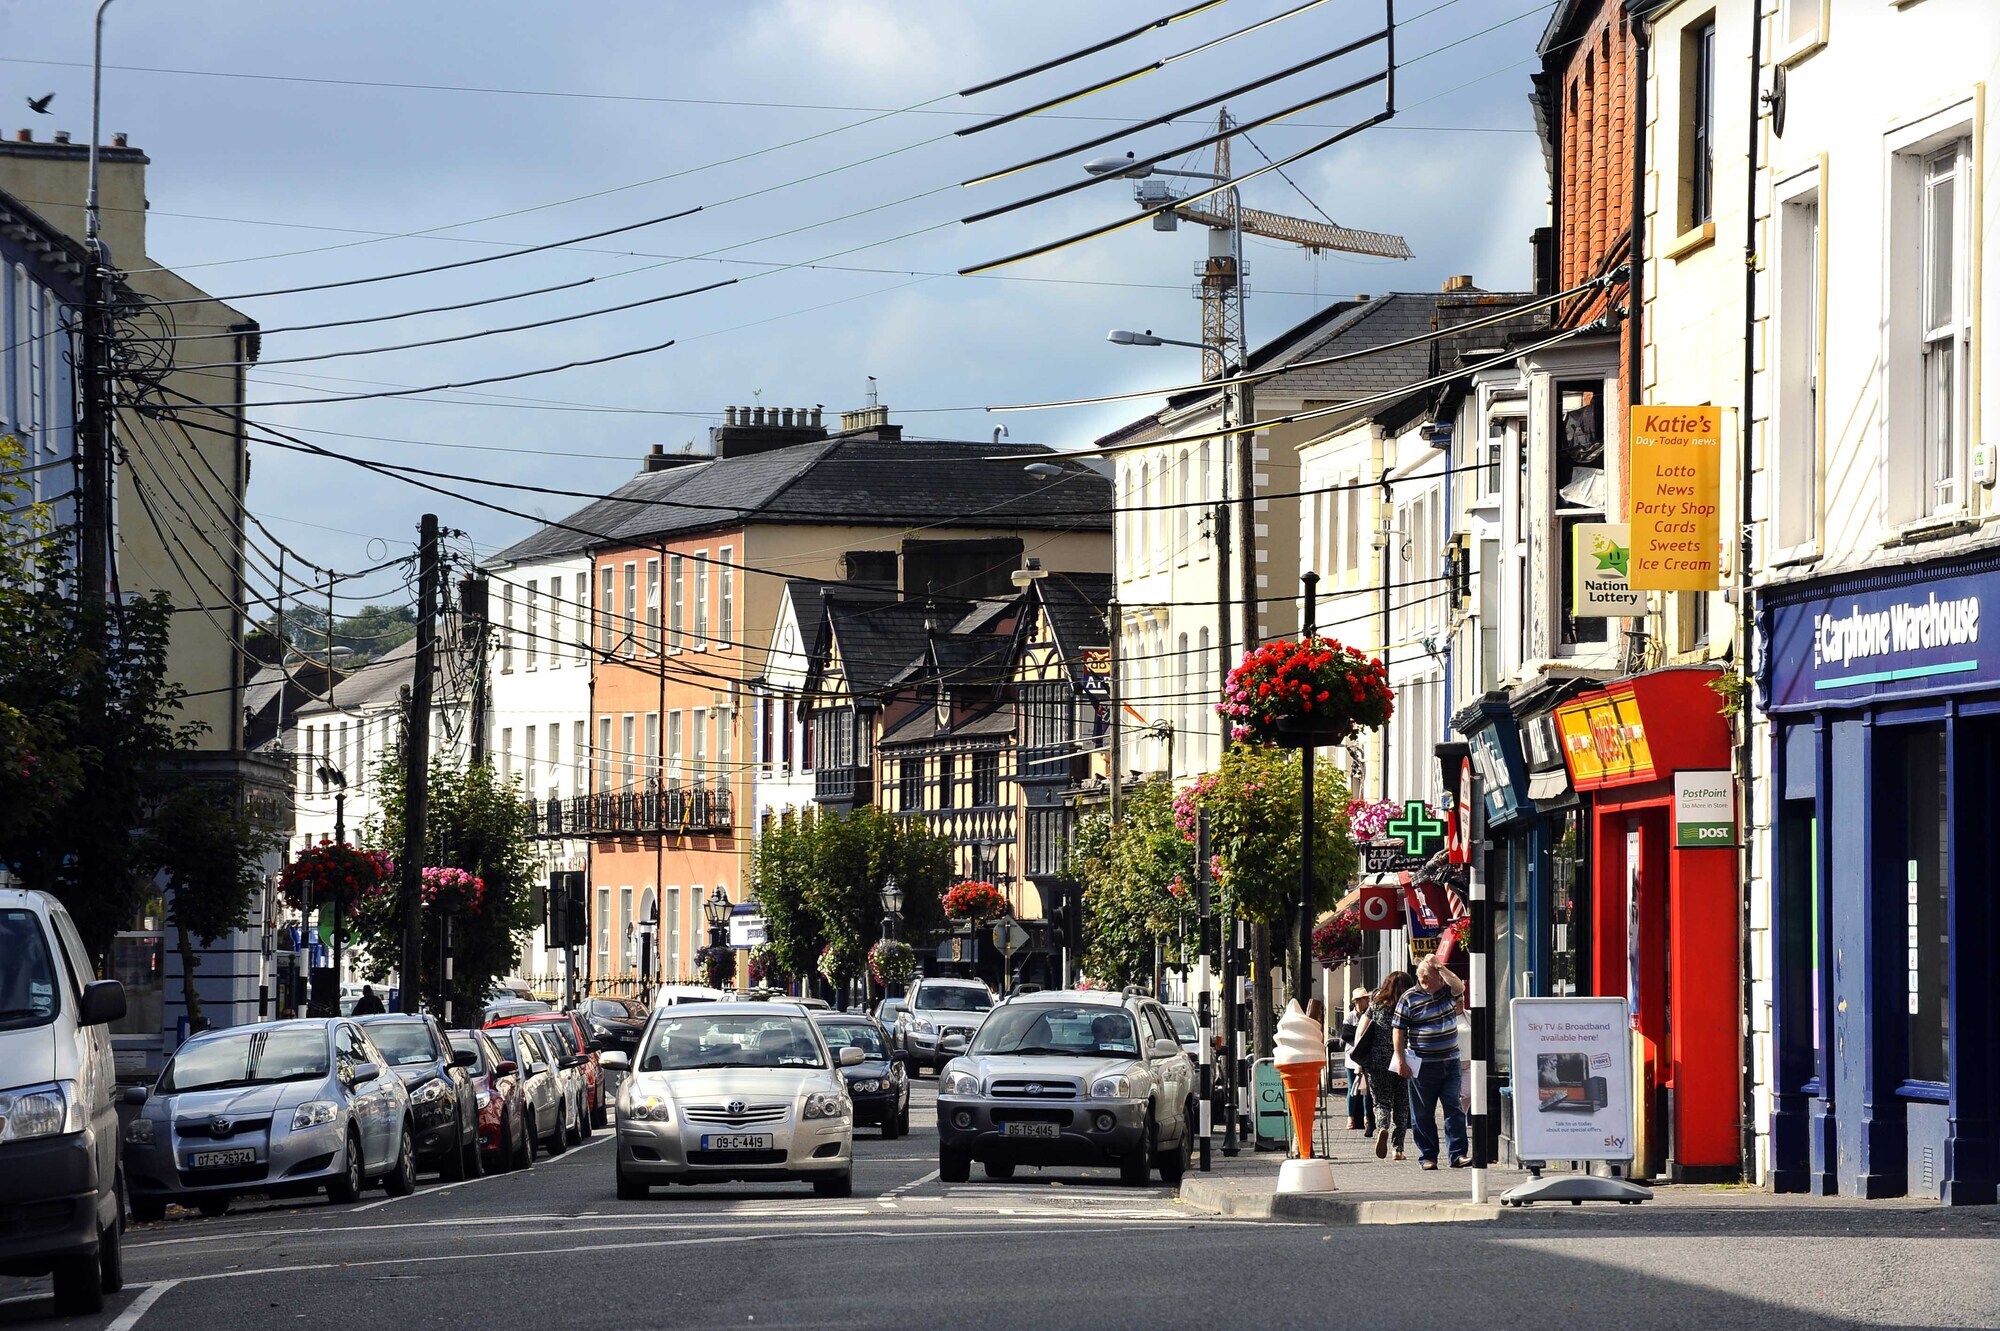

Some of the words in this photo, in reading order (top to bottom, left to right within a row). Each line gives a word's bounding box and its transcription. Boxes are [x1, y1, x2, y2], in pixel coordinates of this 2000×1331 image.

[1645, 415, 1712, 433] Katie's
[1691, 437, 1717, 446] news
[1656, 465, 1696, 477] Lotto
[1656, 484, 1695, 496] News
[1635, 502, 1676, 516] Party
[1681, 502, 1716, 518] Shop
[1654, 521, 1696, 533] Cards
[1650, 539, 1701, 552] Sweets
[1638, 558, 1659, 570] Ice
[1664, 558, 1712, 570] Cream
[1585, 580, 1628, 591] Nation
[1589, 592, 1638, 605] Lottery
[1821, 605, 1891, 667] Carphone
[1890, 592, 1980, 652] Warehouse
[1682, 788, 1727, 798] PostPoint
[1698, 827, 1729, 839] post
[1528, 1023, 1543, 1031] Sky
[1565, 1022, 1610, 1031] Broadband
[1262, 1089, 1285, 1102] CA
[1009, 1124, 1053, 1135] 05-TS-4145
[716, 1137, 763, 1148] 09-C-4419
[1604, 1136, 1625, 1148] sky
[198, 1150, 251, 1166] 07-C-26324
